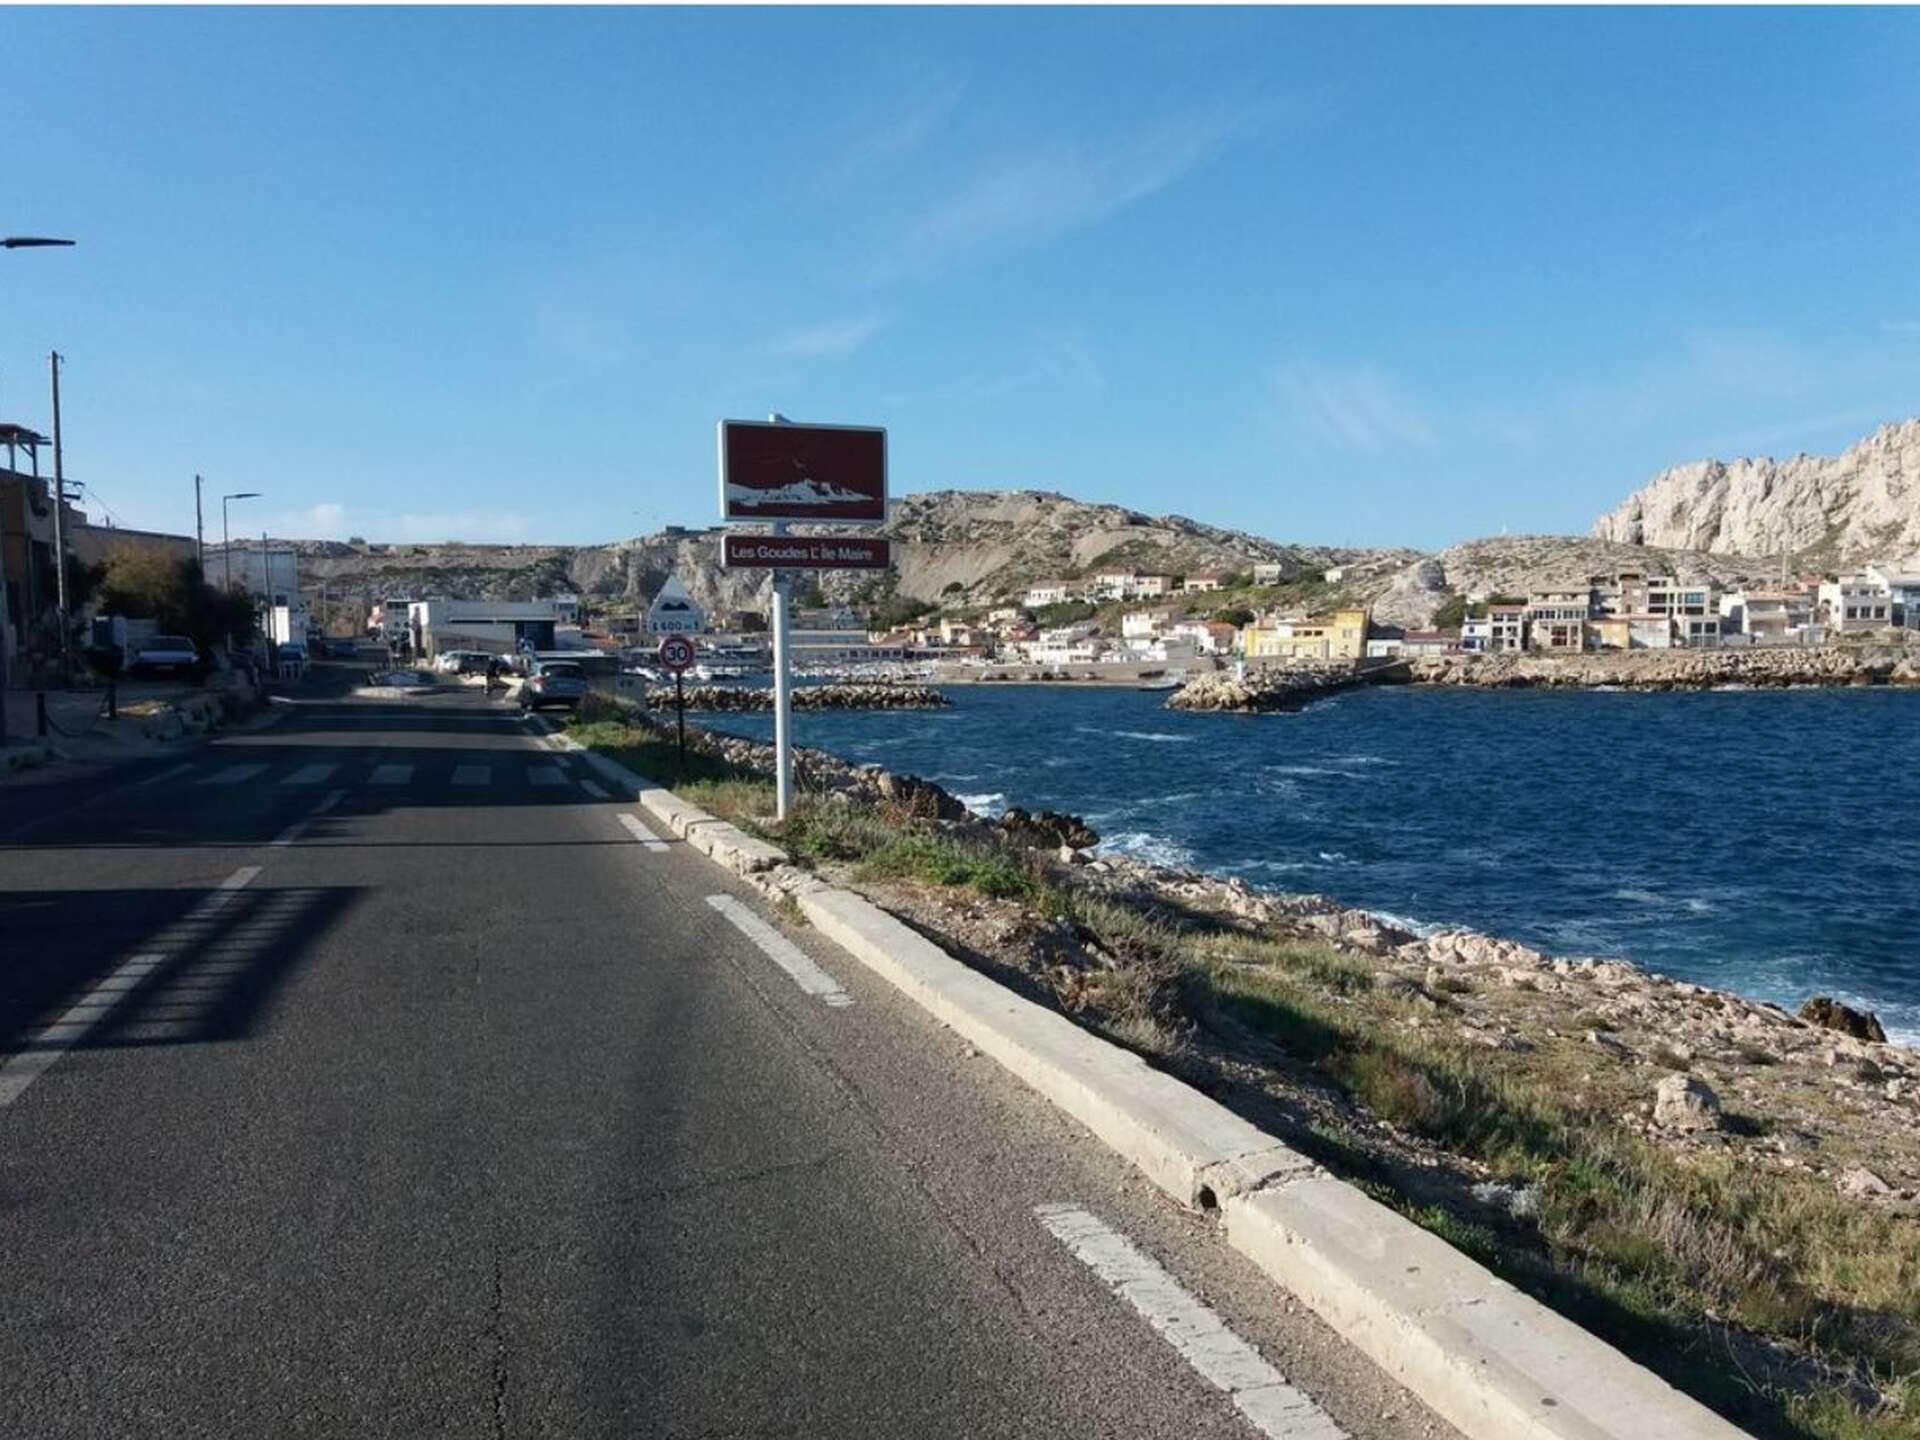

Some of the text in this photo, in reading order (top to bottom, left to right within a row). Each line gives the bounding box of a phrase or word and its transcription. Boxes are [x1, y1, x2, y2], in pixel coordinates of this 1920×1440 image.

[731, 546, 755, 559] Les
[757, 546, 809, 560] Goudes
[838, 547, 873, 561] Maire
[667, 646, 688, 661] 30
